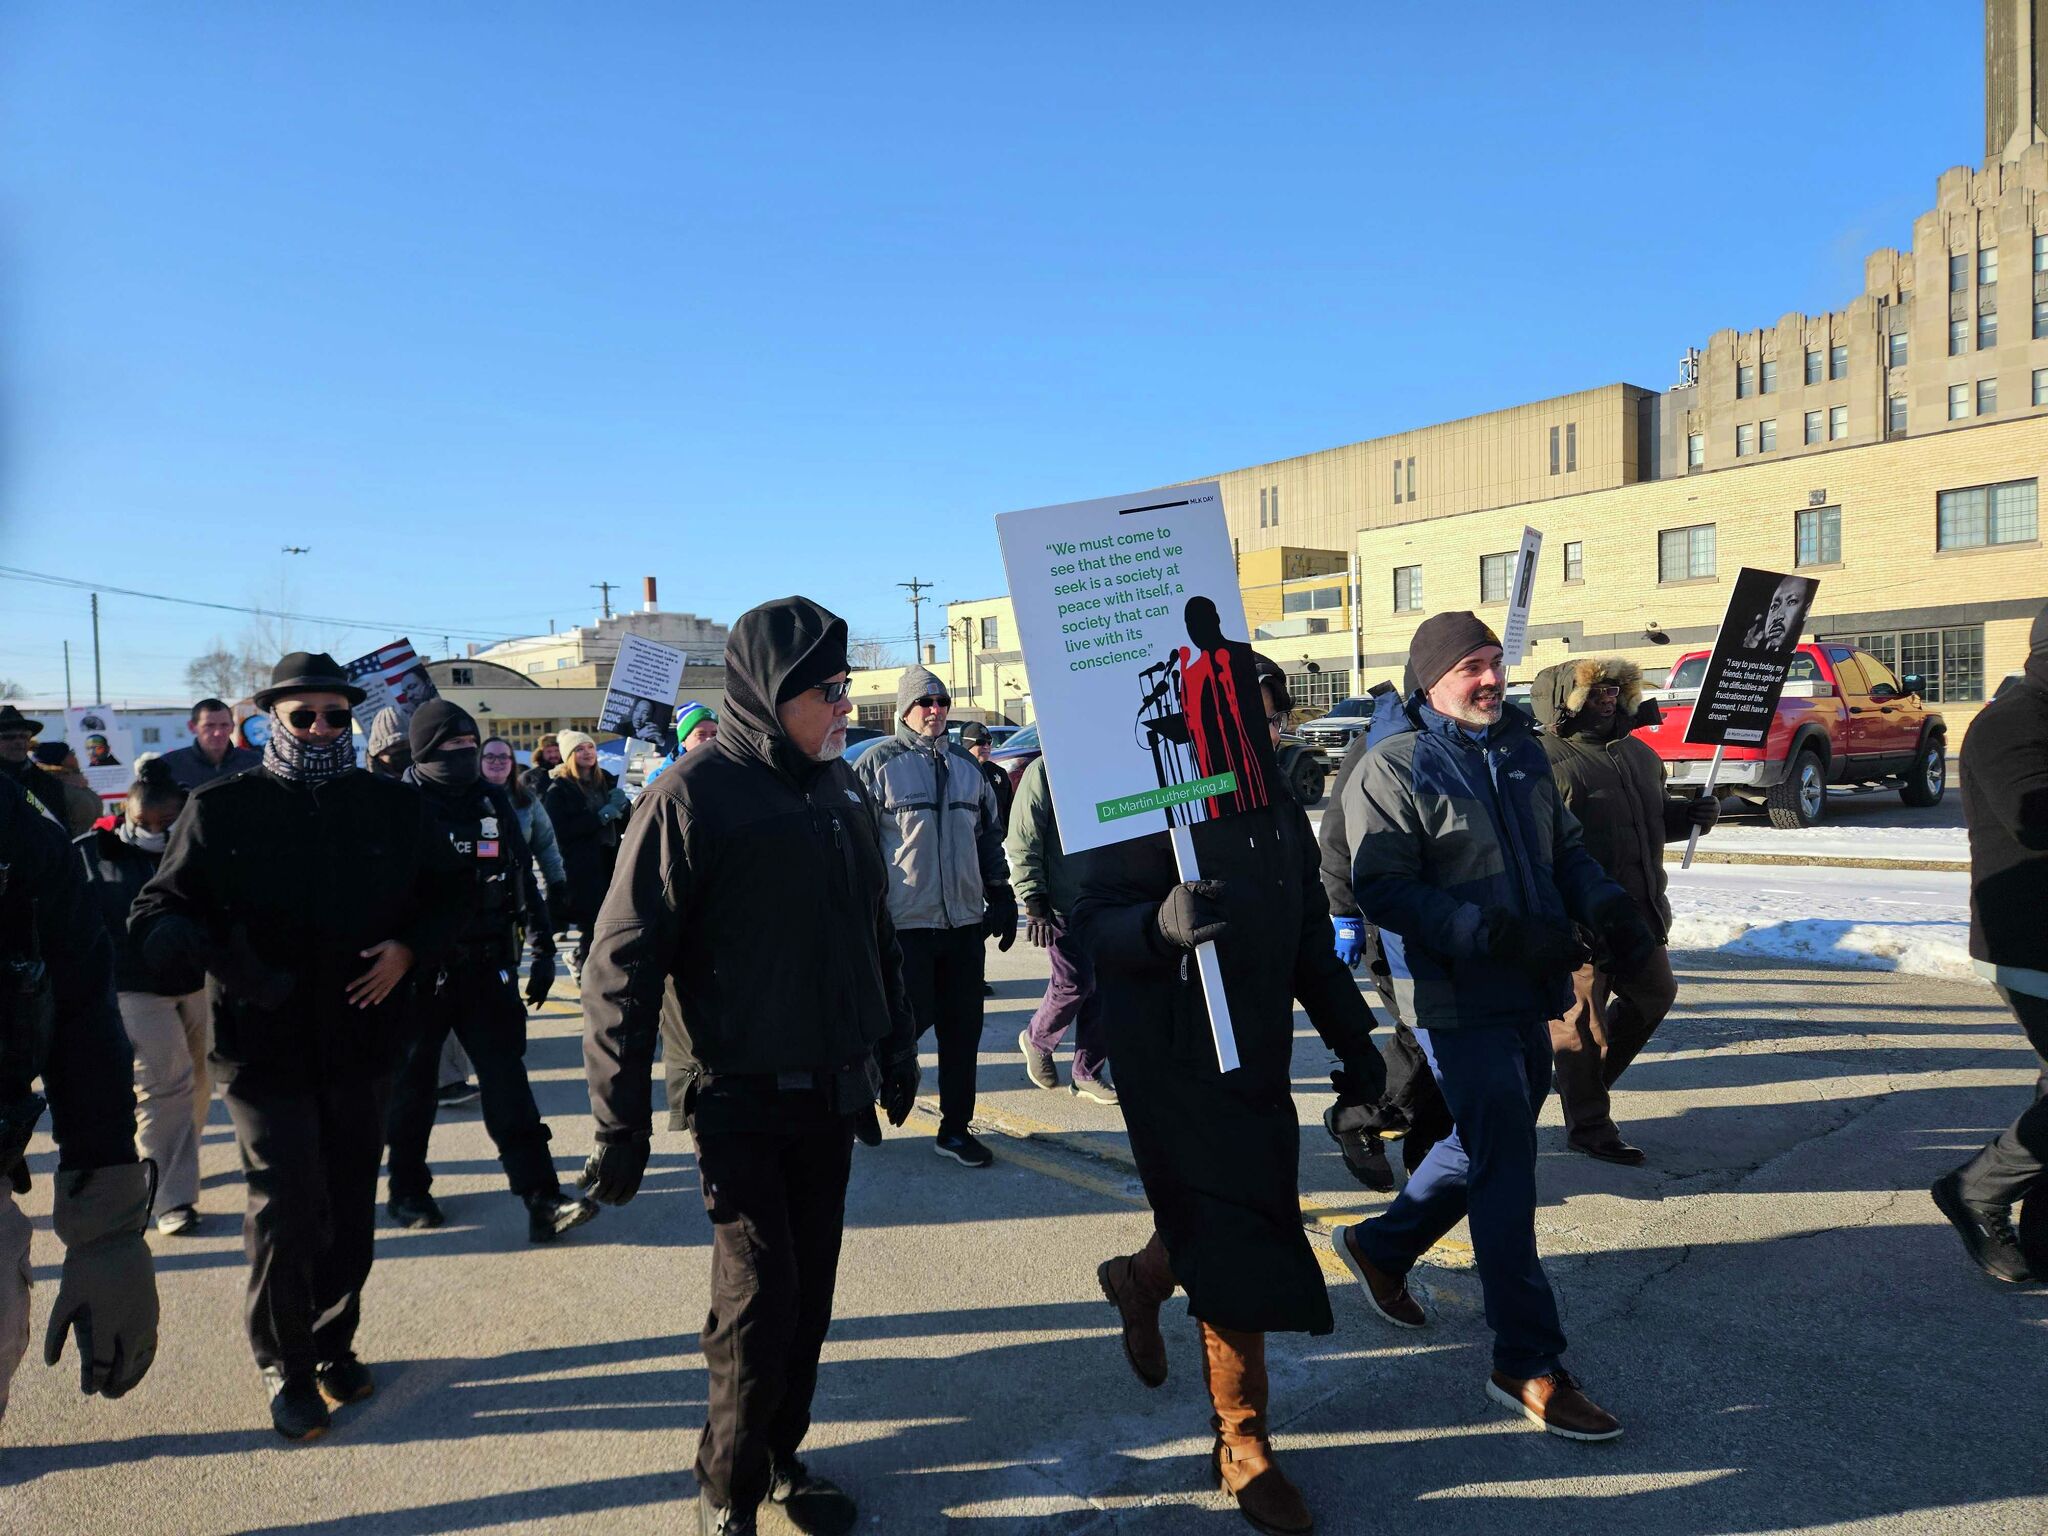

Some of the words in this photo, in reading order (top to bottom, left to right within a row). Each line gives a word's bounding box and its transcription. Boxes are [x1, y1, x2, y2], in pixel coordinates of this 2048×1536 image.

[1080, 535, 1115, 552] must
[1117, 531, 1154, 545] come
[1157, 527, 1171, 539] to
[1050, 564, 1075, 577] see
[1078, 558, 1107, 572] that
[1109, 553, 1131, 566] the
[1135, 546, 1160, 562] end
[1163, 545, 1183, 557] we
[1054, 578, 1088, 596] seek
[1089, 577, 1101, 590] is
[1104, 577, 1113, 587] a
[1115, 566, 1163, 585] society
[1166, 562, 1180, 576] at
[1057, 598, 1101, 618] peace
[1103, 590, 1134, 606] with
[1135, 582, 1173, 601] itself,
[1175, 583, 1184, 593] a
[1062, 615, 1111, 634] society
[1114, 607, 1143, 624] that
[1145, 605, 1169, 618] can
[1065, 639, 1091, 653] live
[1093, 631, 1124, 647] with
[1126, 628, 1143, 641] its
[1731, 660, 1742, 669] say
[1741, 660, 1748, 668] to
[1748, 662, 1759, 670] you
[1760, 662, 1775, 673] today,
[1775, 665, 1785, 674] my
[1722, 668, 1743, 679] friends,
[1743, 671, 1756, 680] that
[1756, 672, 1761, 680] in
[1761, 673, 1775, 683] spite
[1775, 675, 1783, 683] of
[1718, 680, 1729, 688] the
[1729, 681, 1757, 691] difficulties
[1757, 684, 1770, 692] and
[607, 692, 635, 706] MARTIN
[1715, 690, 1748, 701] frustrations
[1747, 694, 1755, 702] of
[1754, 694, 1764, 702] the
[606, 702, 631, 715] LUTHER
[1711, 703, 1736, 711] moment,
[1736, 703, 1741, 711] I
[1740, 704, 1752, 712] still
[1751, 704, 1764, 713] have
[603, 711, 621, 724] KING
[601, 720, 616, 731] DAY
[1102, 805, 1118, 817] Dr.
[1119, 797, 1154, 813] Martin
[1155, 789, 1190, 805] Luther
[1192, 783, 1217, 795] King
[1218, 778, 1230, 789] Jr.
